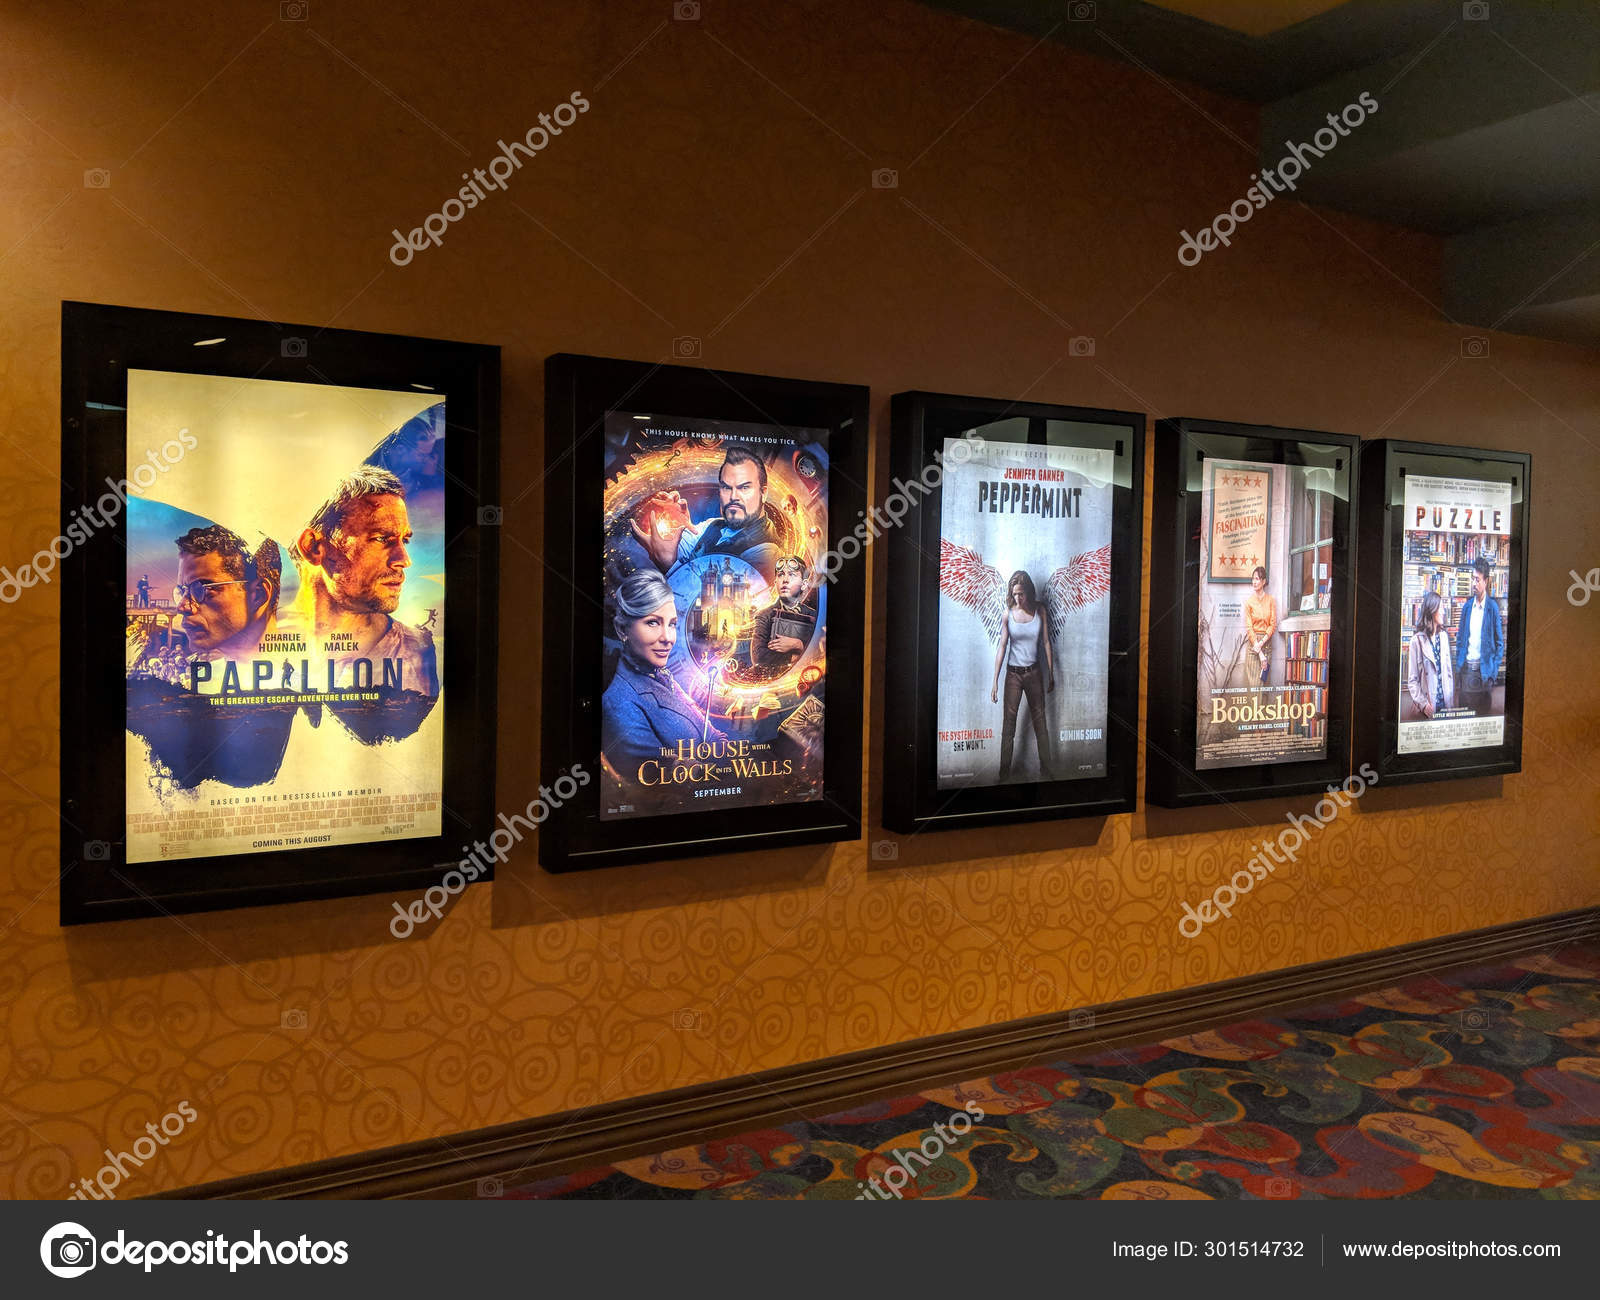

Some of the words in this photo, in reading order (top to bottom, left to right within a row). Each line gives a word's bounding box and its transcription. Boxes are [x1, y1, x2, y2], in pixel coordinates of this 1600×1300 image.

[1004, 467, 1036, 480] JENNIFER
[1039, 469, 1064, 482] GARNER
[978, 481, 1082, 518] PEPPERMINT
[1216, 513, 1264, 534] FASCINATING
[1416, 506, 1500, 530] PUZZLE
[264, 633, 301, 642] CHARLIE
[259, 642, 306, 652] HUNNAM
[324, 642, 359, 651] MALEK
[227, 696, 264, 704] GREATEST
[298, 694, 339, 702] ADVENTURE
[1232, 696, 1247, 704] THE
[1211, 695, 1316, 726] Bookshop
[938, 731, 948, 742] THE
[950, 730, 972, 740] SYSTEM
[1060, 730, 1085, 741] COMING
[1085, 728, 1102, 740] SOON
[659, 746, 675, 756] THE
[676, 738, 750, 760] HOUSE
[954, 741, 964, 751] SHE
[638, 760, 720, 786] CLOCK
[732, 758, 793, 779] WALLS
[210, 798, 240, 806] BASED
[283, 791, 342, 801] BESTSELLING
[348, 788, 382, 796] MEMOIR
[694, 787, 742, 798] SEPTEMBER
[252, 837, 283, 848] COMING
[285, 836, 302, 845] THIS
[303, 835, 332, 844] AUGUST
